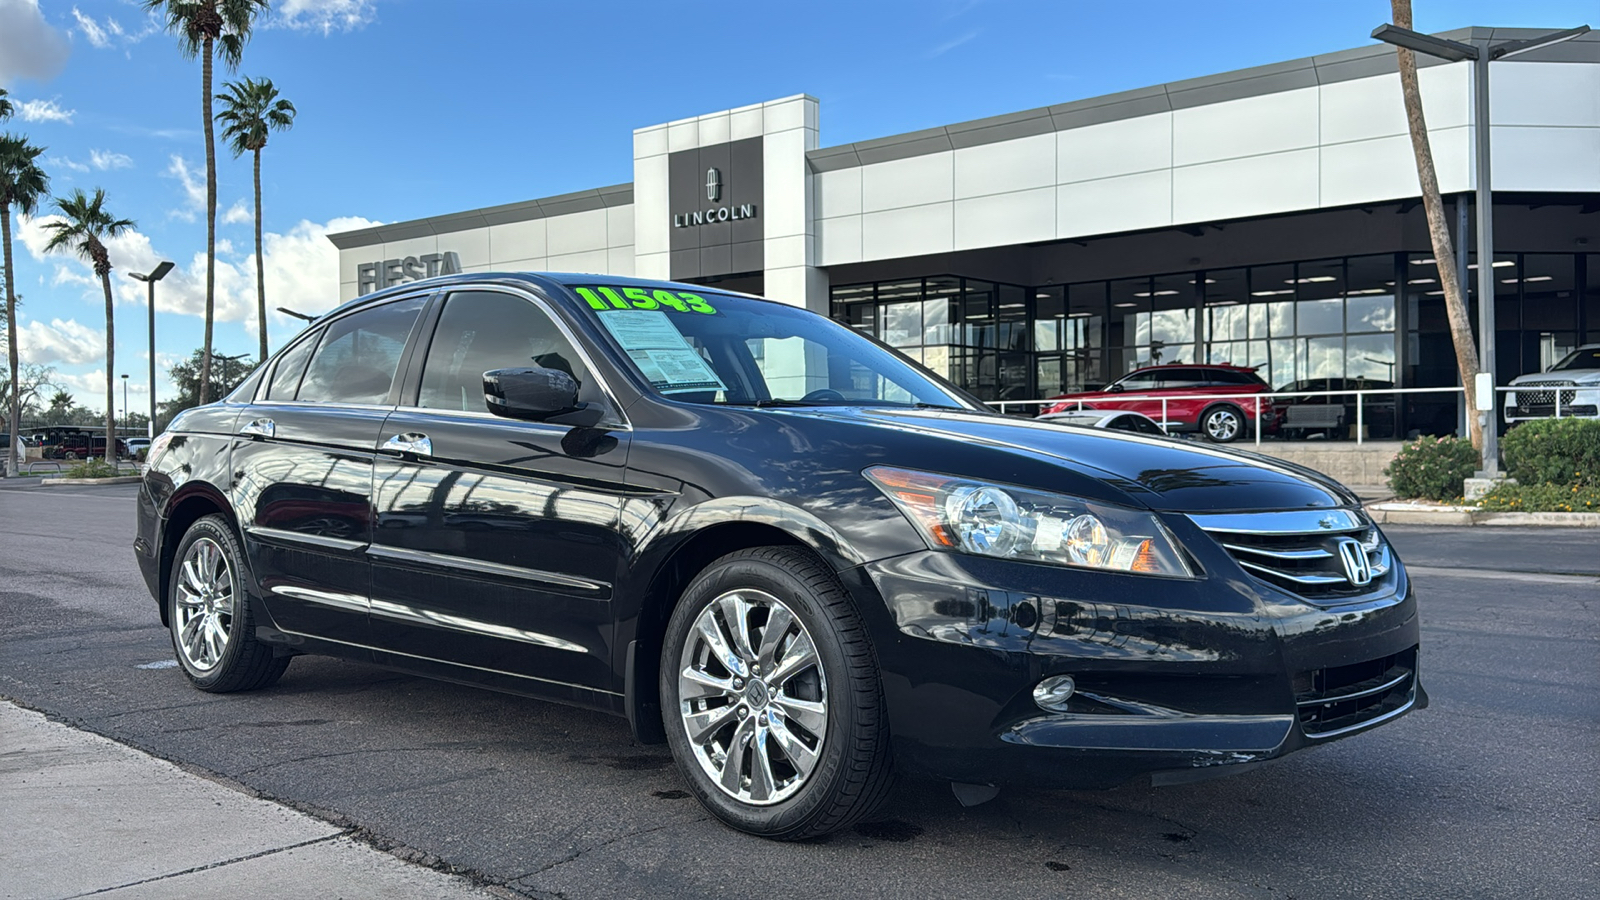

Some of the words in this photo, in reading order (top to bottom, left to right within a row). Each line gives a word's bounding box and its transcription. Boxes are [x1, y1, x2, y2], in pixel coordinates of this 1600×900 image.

[674, 203, 752, 228] LINCOLN
[357, 251, 463, 297] FIESTA
[575, 286, 718, 315] 11543
